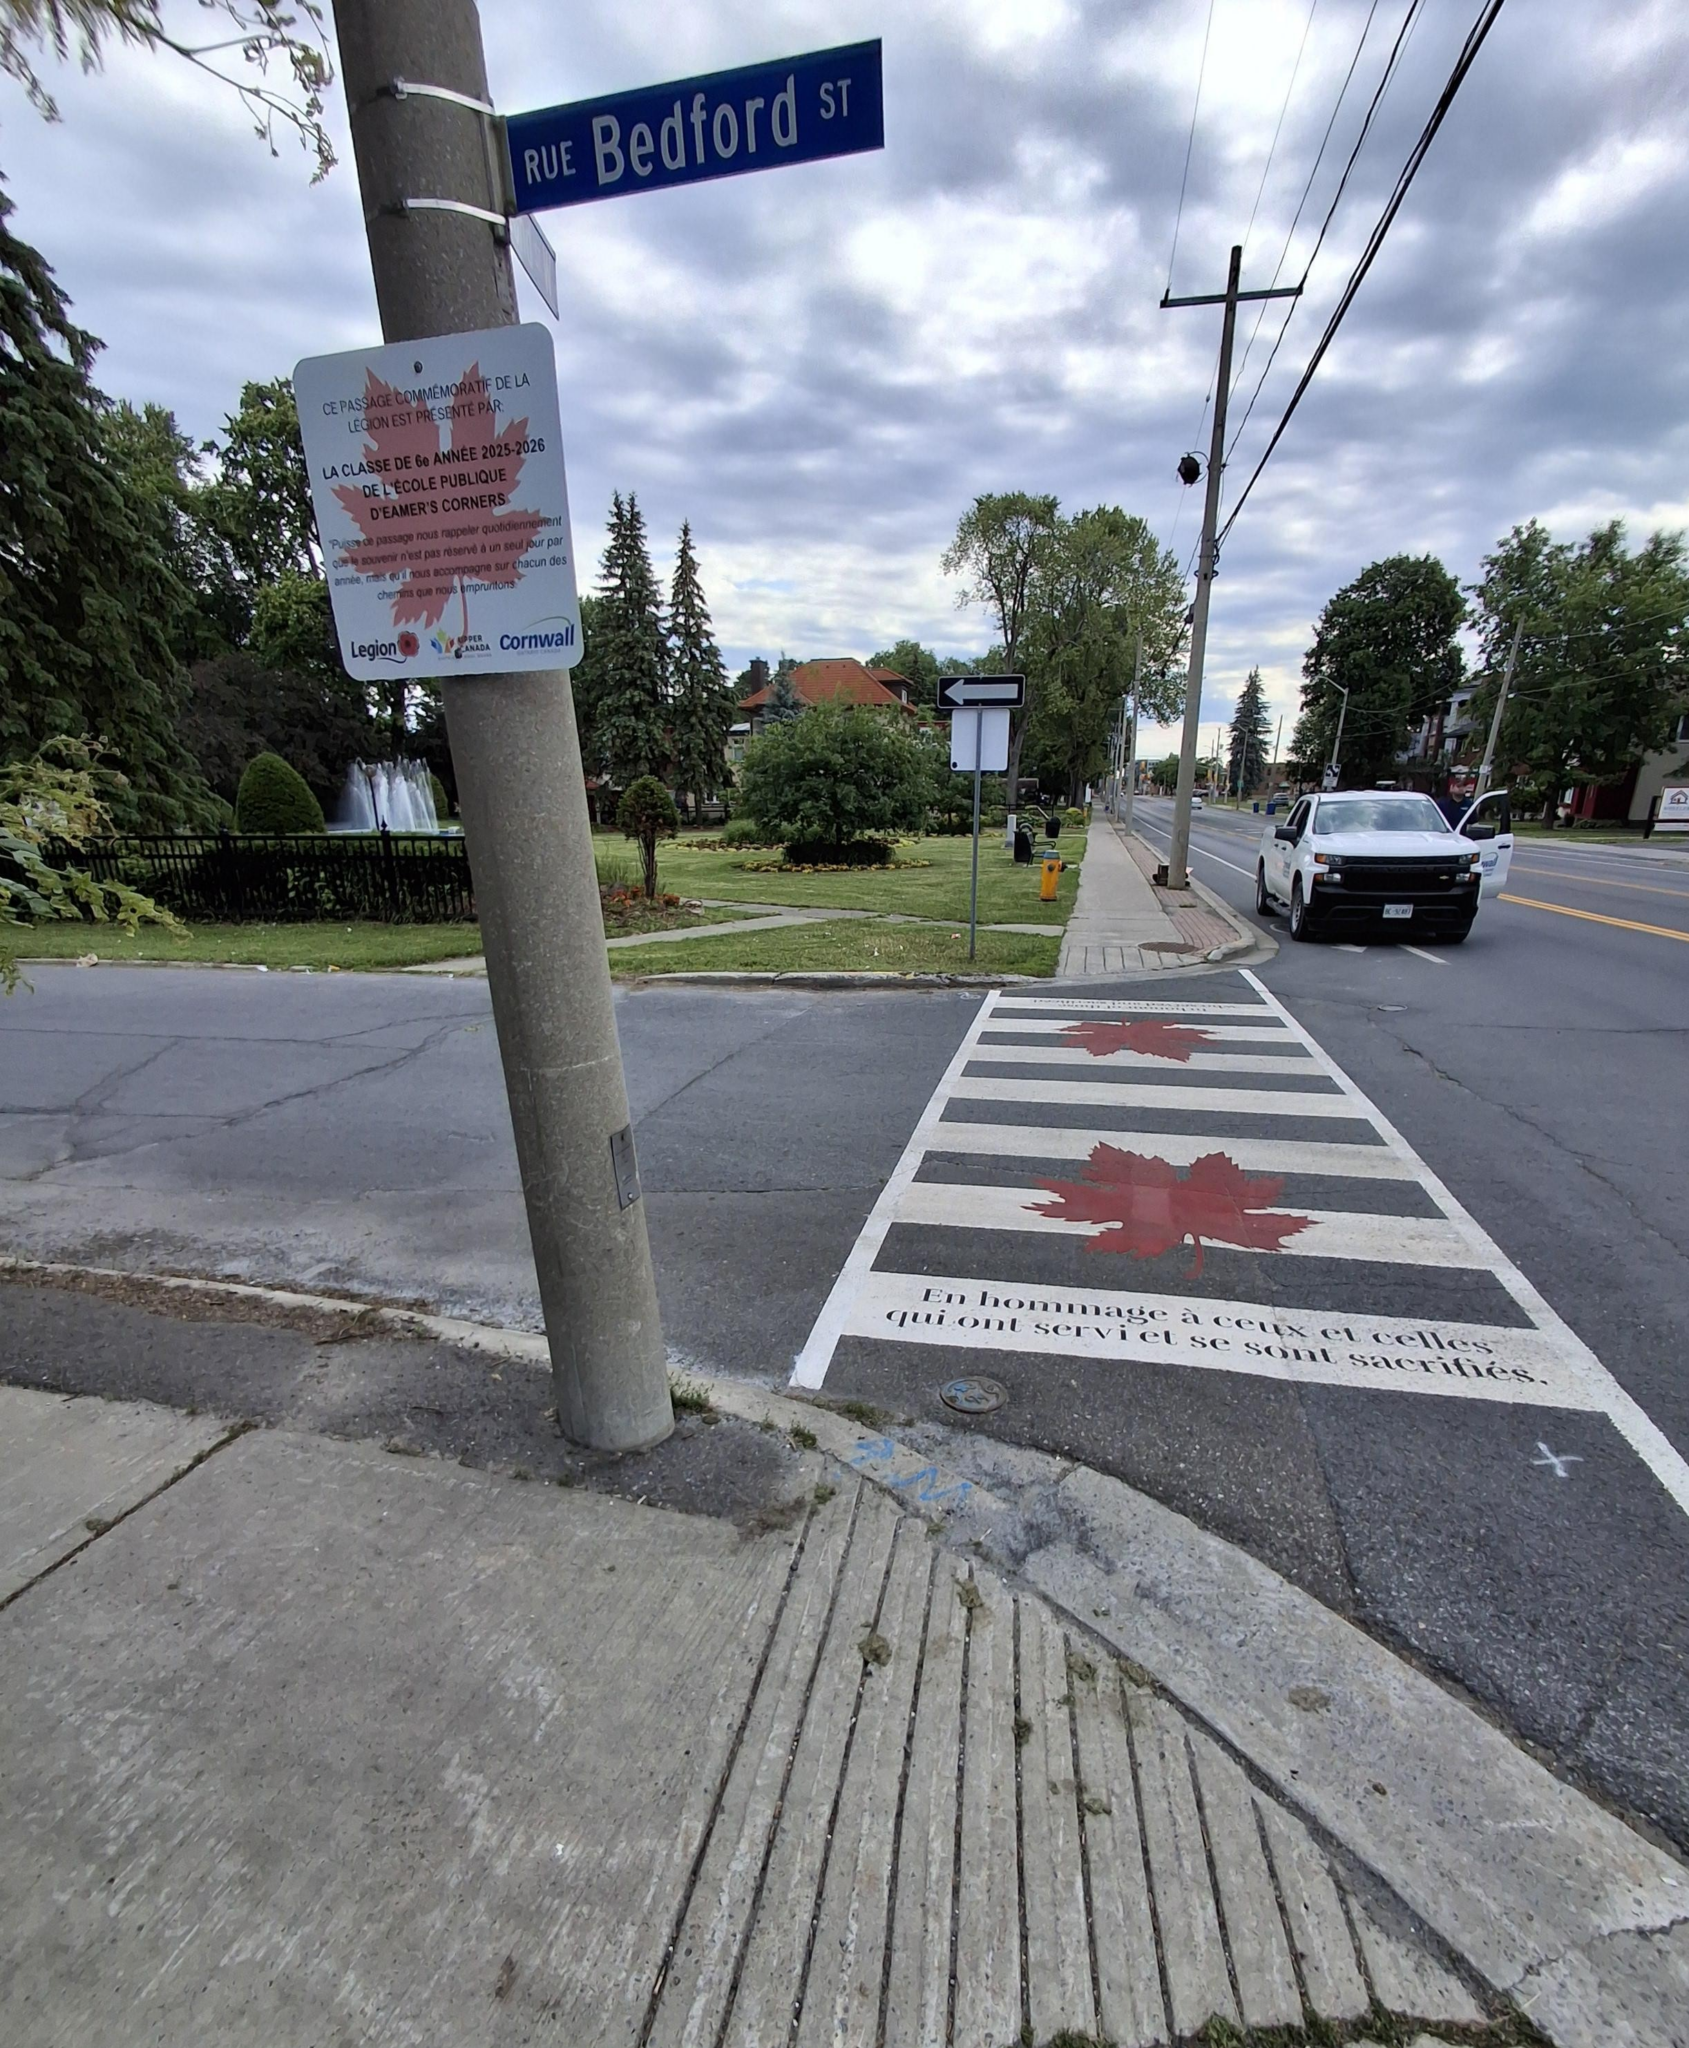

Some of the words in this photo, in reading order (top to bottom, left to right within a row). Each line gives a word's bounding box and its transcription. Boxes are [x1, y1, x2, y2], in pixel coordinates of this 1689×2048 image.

[523, 139, 577, 185] RUE
[592, 74, 799, 186] Bedford
[819, 78, 852, 120] ST
[322, 402, 338, 416] CE
[340, 393, 393, 413] PASSAGE
[395, 377, 493, 405] COMMÉMORATIF
[495, 375, 512, 391] DE
[515, 372, 531, 388] LA
[393, 411, 413, 427] EST
[416, 401, 475, 424] PRÉSENTÉ
[478, 397, 505, 415] PAR:
[322, 466, 339, 480] LA
[341, 460, 391, 477] CLASSE
[394, 455, 412, 471] DE
[415, 453, 430, 468] 6e
[433, 444, 477, 466] ANNÉE
[481, 437, 546, 459] 2025-2026
[362, 484, 380, 499] DE
[382, 475, 437, 498] L'ÉCOLE
[440, 467, 507, 490] PUBLIQUE
[370, 500, 439, 521] D'EAMER'S
[441, 493, 506, 513] CORNERS
[363, 537, 374, 547] ce
[376, 532, 415, 548] passage
[416, 529, 440, 541] nous
[441, 524, 480, 538] rappeler
[482, 516, 562, 536] quotidiennement
[332, 556, 349, 570] que
[351, 555, 359, 566] le
[361, 552, 399, 567] souvenir
[400, 549, 423, 561] n'est
[424, 548, 441, 560] pas
[480, 542, 487, 553] à
[489, 542, 502, 553] un
[504, 540, 524, 552] seul
[525, 539, 545, 553] jour
[547, 536, 564, 549] par
[366, 573, 388, 584] mais
[409, 567, 431, 579] nous
[433, 564, 492, 577] accompagne
[495, 561, 510, 571] sur
[512, 557, 547, 570] chacun
[549, 555, 567, 567] des
[377, 588, 414, 601] chemins
[416, 587, 434, 599] que
[435, 585, 458, 596] nous
[351, 639, 397, 662] Legion
[500, 623, 575, 651] Cornwall
[923, 1287, 966, 1307] En
[979, 1290, 1168, 1325] hommage
[1181, 1306, 1204, 1326] à
[1213, 1314, 1308, 1339] ceux
[1320, 1326, 1361, 1343] et
[1372, 1329, 1495, 1356] celles
[886, 1308, 947, 1329] qui
[957, 1314, 1023, 1334] ont
[1033, 1320, 1128, 1342] servi
[1139, 1328, 1178, 1346] et
[1190, 1333, 1232, 1352] se
[1245, 1341, 1338, 1365] sont
[1349, 1352, 1549, 1386] sacrifiés.
